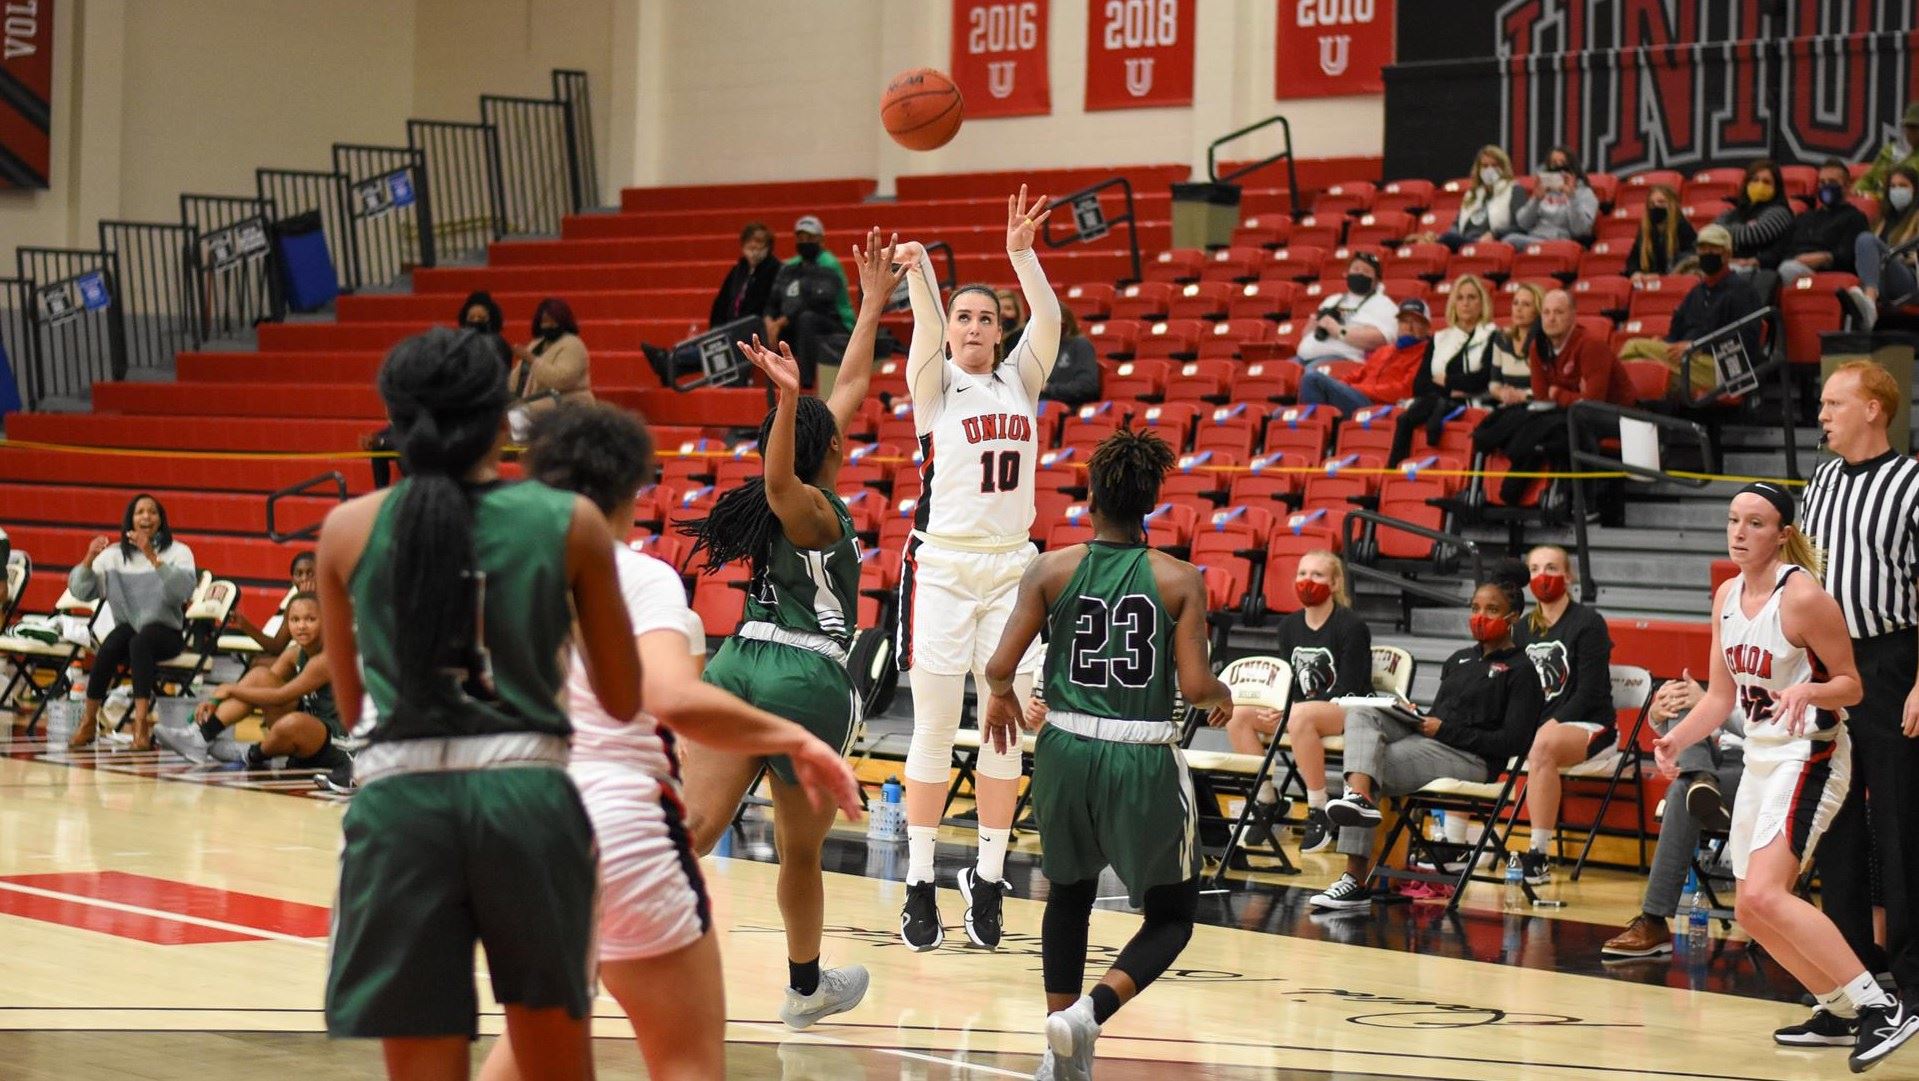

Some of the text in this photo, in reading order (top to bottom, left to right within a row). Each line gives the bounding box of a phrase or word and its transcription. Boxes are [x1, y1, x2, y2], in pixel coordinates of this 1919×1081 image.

[969, 3, 1037, 54] 2016
[1104, 0, 1178, 50] 2018
[1318, 34, 1352, 76] U
[987, 60, 1017, 98] U
[1124, 57, 1155, 97] U
[961, 413, 1032, 445] UNION
[980, 450, 1021, 493] 10
[1069, 593, 1157, 689] 23
